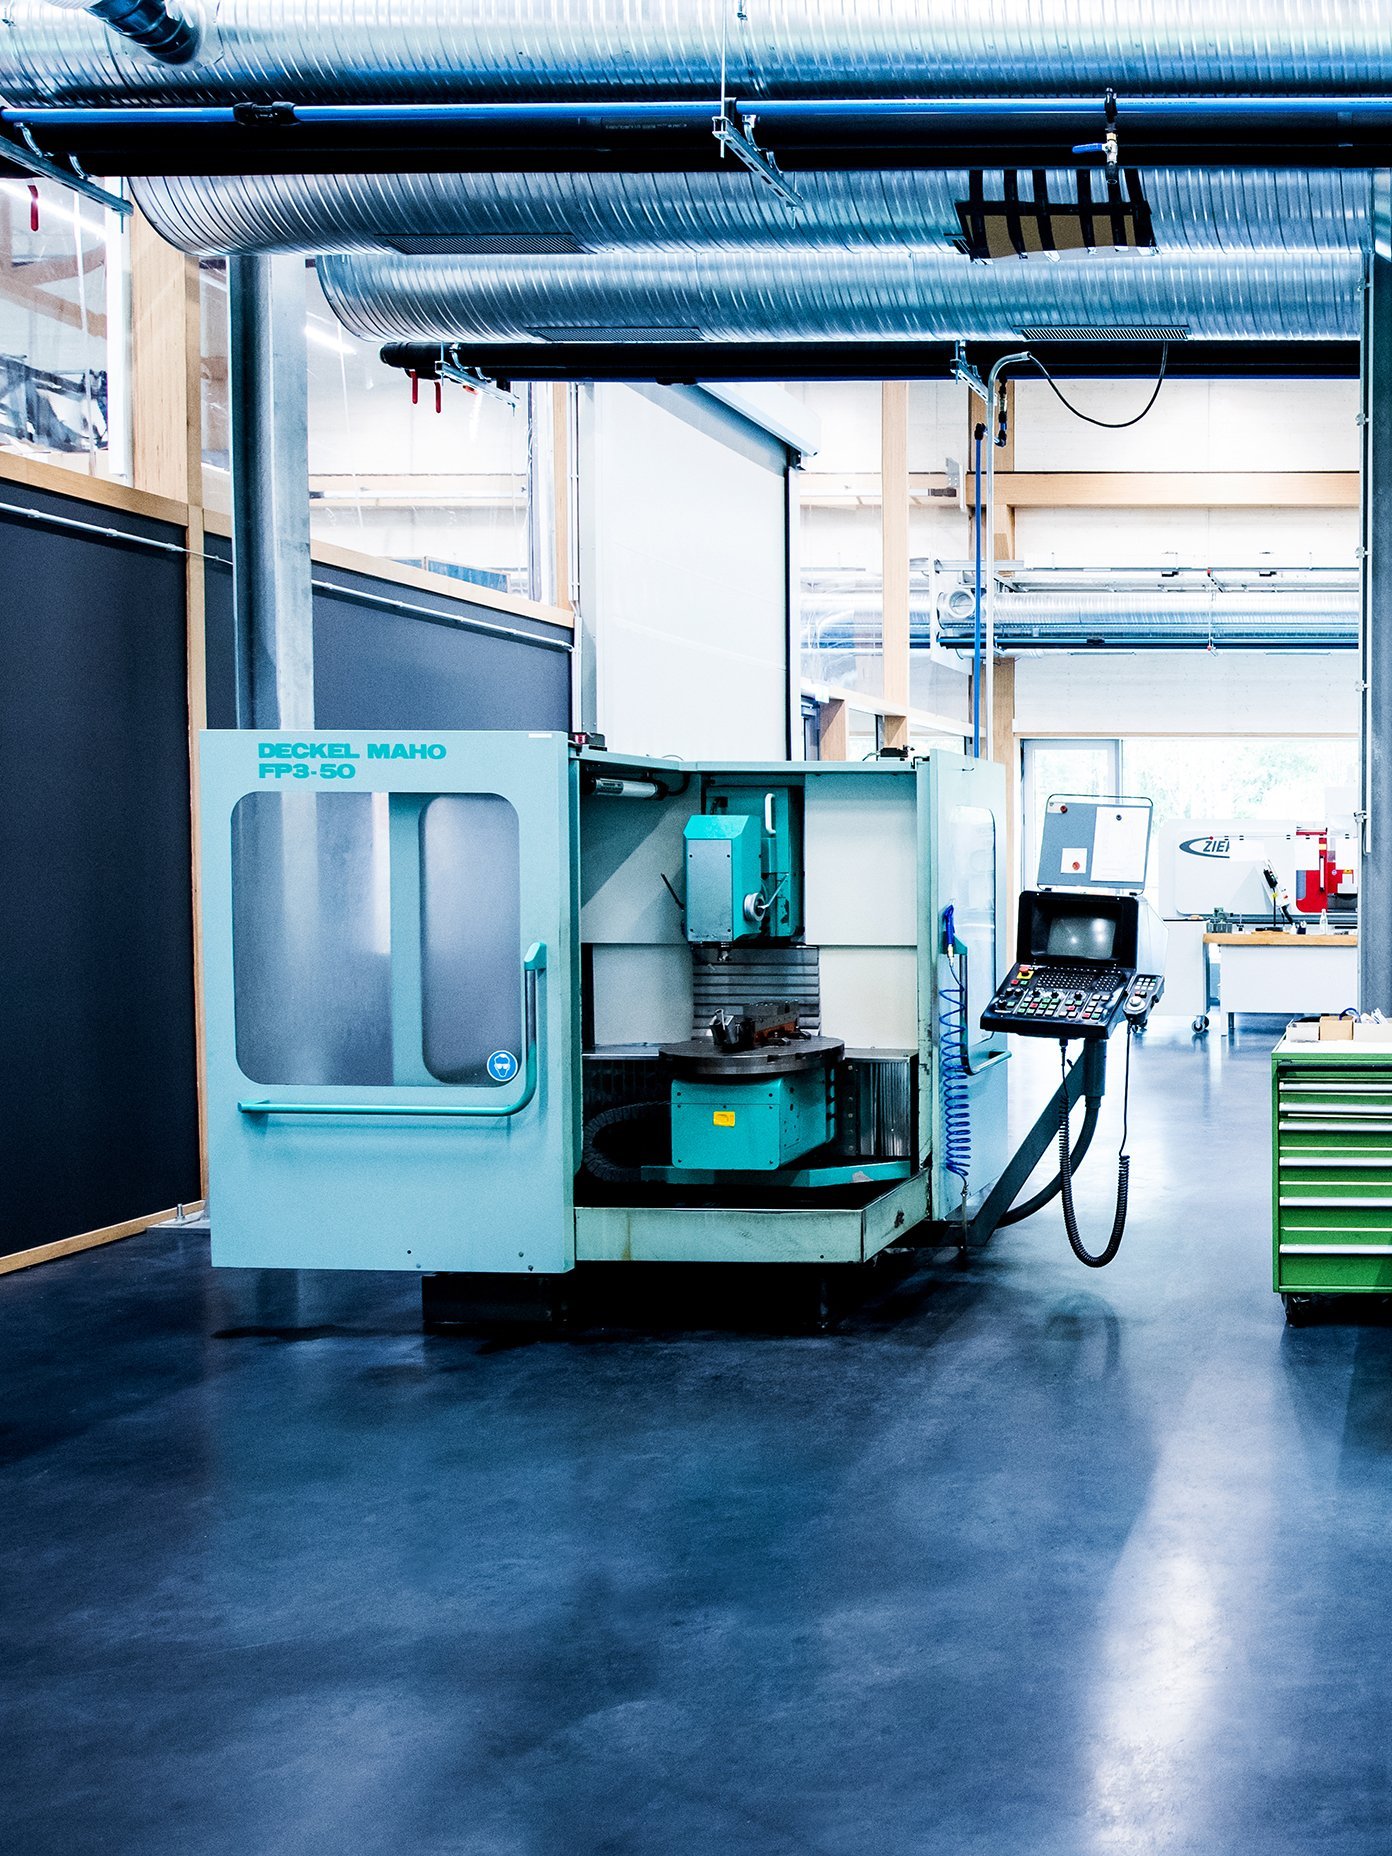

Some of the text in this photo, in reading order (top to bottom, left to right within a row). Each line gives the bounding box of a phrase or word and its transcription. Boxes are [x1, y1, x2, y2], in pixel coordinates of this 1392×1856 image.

[257, 742, 447, 760] DECKEL MAHO
[258, 763, 356, 780] FP3-50
